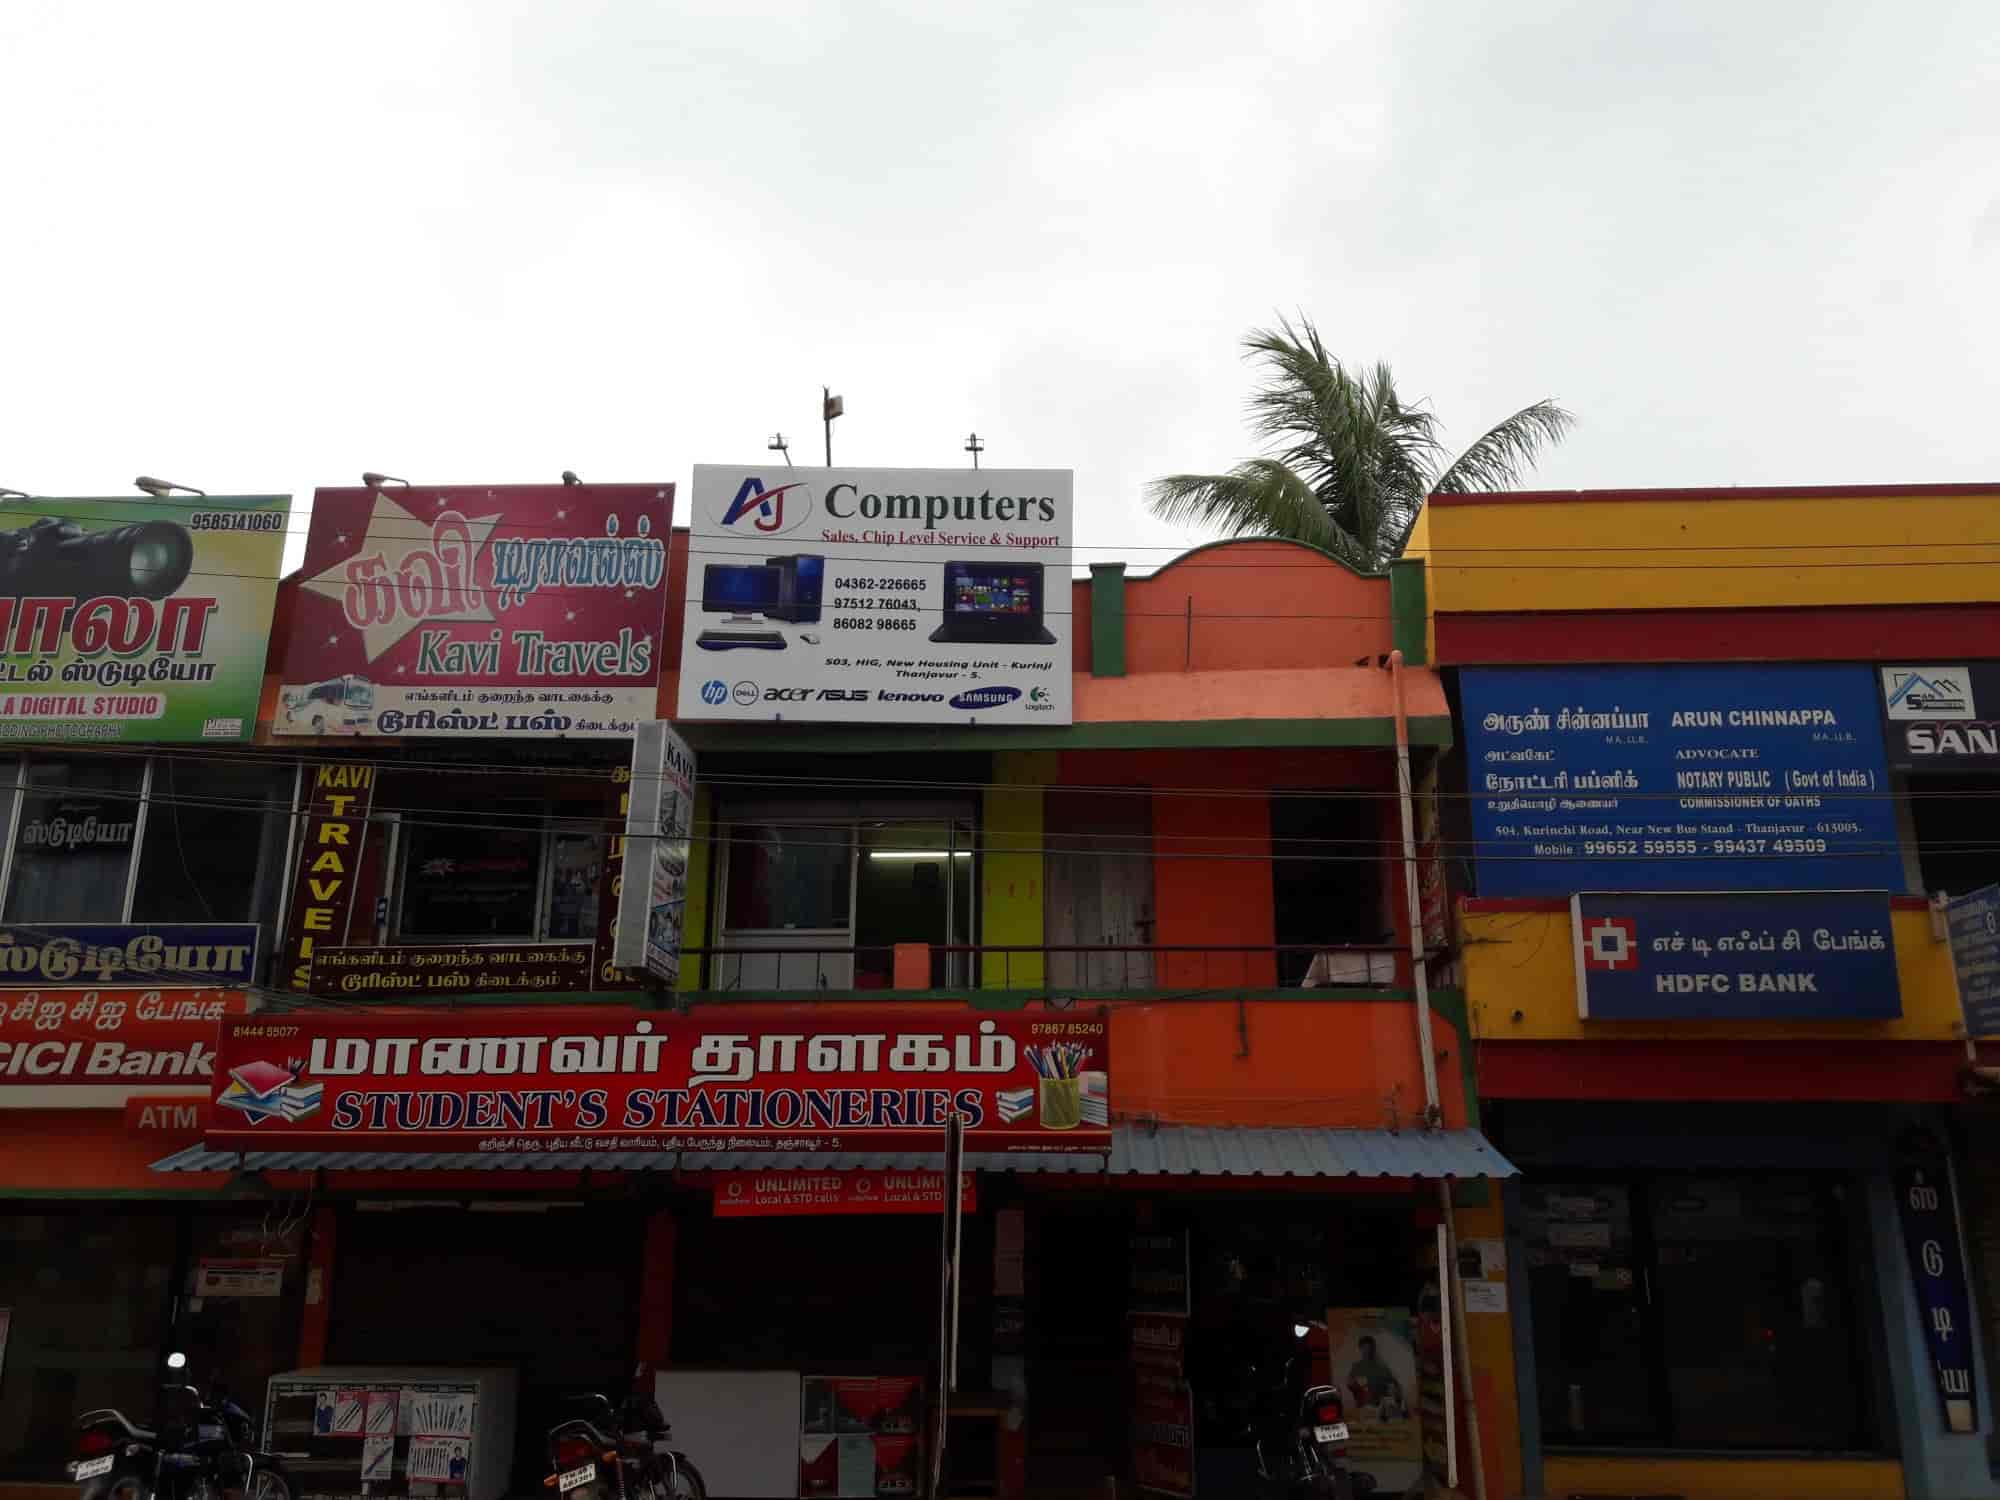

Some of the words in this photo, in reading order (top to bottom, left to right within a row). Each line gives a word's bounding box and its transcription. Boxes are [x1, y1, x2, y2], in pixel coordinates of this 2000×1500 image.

[720, 477, 808, 532] AJ
[824, 483, 1056, 529] Computers
[191, 513, 282, 530] 9585141060
[863, 530, 895, 546] Chip
[899, 531, 934, 544] Level
[939, 532, 986, 545] Service
[990, 533, 1001, 545] &
[1007, 534, 1059, 548] Support
[343, 510, 486, 627] கவி
[491, 514, 664, 609] டிராவல்ஸ்
[834, 578, 926, 590] 04362-226665
[834, 598, 873, 609] 97512
[833, 618, 873, 630] 86082
[877, 619, 916, 630] 98665
[416, 630, 501, 675] Kavi
[513, 628, 652, 677] Travels
[62, 657, 216, 686] ஸ்டுடியோ
[886, 659, 914, 667] New
[918, 660, 969, 669] Housing
[1011, 662, 1053, 670] Kurinji
[896, 670, 958, 679] Thanjavur
[703, 681, 726, 705] hp
[764, 688, 814, 701] acer
[816, 689, 869, 701] ASUS
[877, 690, 944, 702] lenovo
[959, 693, 1014, 705] SAMSUNG
[0, 697, 14, 715] A
[20, 696, 86, 715] DIGITAL
[94, 696, 157, 715] STUDIO
[376, 710, 497, 734] டூரிஸ்ட்
[505, 709, 572, 732] பஸ்
[1483, 707, 1550, 735] அருண்
[1557, 706, 1649, 730] சின்னப்பா
[1671, 711, 1723, 727] ARUN
[1729, 709, 1836, 726] CHINNAPPA
[1675, 749, 1760, 760] ADVOCATE
[317, 764, 374, 789] KAVI
[1486, 771, 1568, 792] நோட்டரி
[1677, 771, 1723, 789] NOTARY
[1728, 770, 1771, 788] PUBLIC
[1823, 770, 1834, 787] of
[1680, 796, 1764, 808] COMMISSIONER
[1767, 796, 1781, 807] OF
[1785, 796, 1821, 807] OATHS
[23, 816, 134, 849] ஸ்டுடியோ
[1616, 825, 1643, 834] Near
[1648, 824, 1673, 833] New
[1676, 824, 1697, 833] Bus
[1701, 823, 1733, 833] Stand
[1744, 823, 1806, 834] Thanjavur
[1535, 844, 1573, 855] Mobile
[1584, 840, 1638, 854] 99652
[1644, 840, 1697, 854] 59555
[1714, 839, 1766, 853] 99437
[1774, 839, 1826, 852] 49509
[291, 795, 357, 988] TRAVELS
[1653, 931, 1685, 952] எச்
[1692, 935, 1712, 958] டி
[1781, 929, 1801, 950] சி
[1813, 928, 1886, 951] பேங்க்
[428, 972, 470, 988] பஸ்
[1656, 973, 1730, 993] HDFC
[1739, 973, 1817, 993] BANK
[136, 991, 226, 1021] பேங்க்
[85, 1041, 217, 1076] Bank
[309, 1019, 669, 1076] மாணவர்
[689, 1019, 1017, 1088] தாளகம்
[138, 1105, 197, 1128] ATM
[623, 1088, 983, 1128] STATIONERIES
[755, 1177, 842, 1192] UNLIMITED
